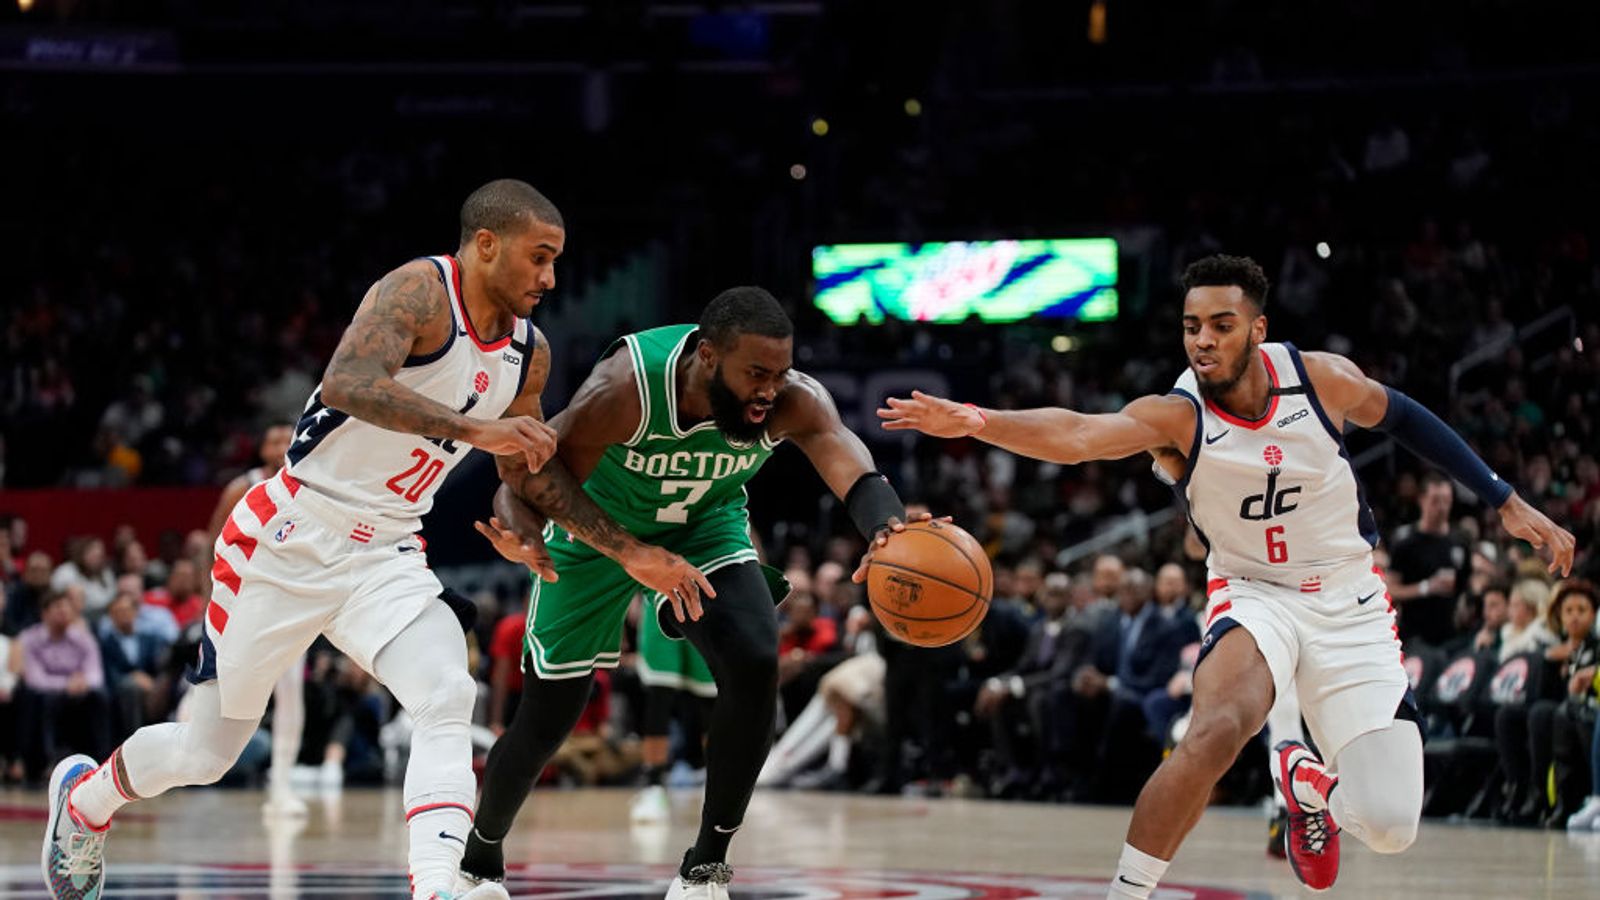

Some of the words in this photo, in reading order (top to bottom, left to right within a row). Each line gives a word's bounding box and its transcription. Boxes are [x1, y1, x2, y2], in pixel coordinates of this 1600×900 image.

[1277, 409, 1309, 428] GEICO
[385, 447, 445, 504] 20
[624, 448, 758, 480] BOSTON
[656, 479, 714, 524] 7
[1265, 525, 1288, 564] 6
